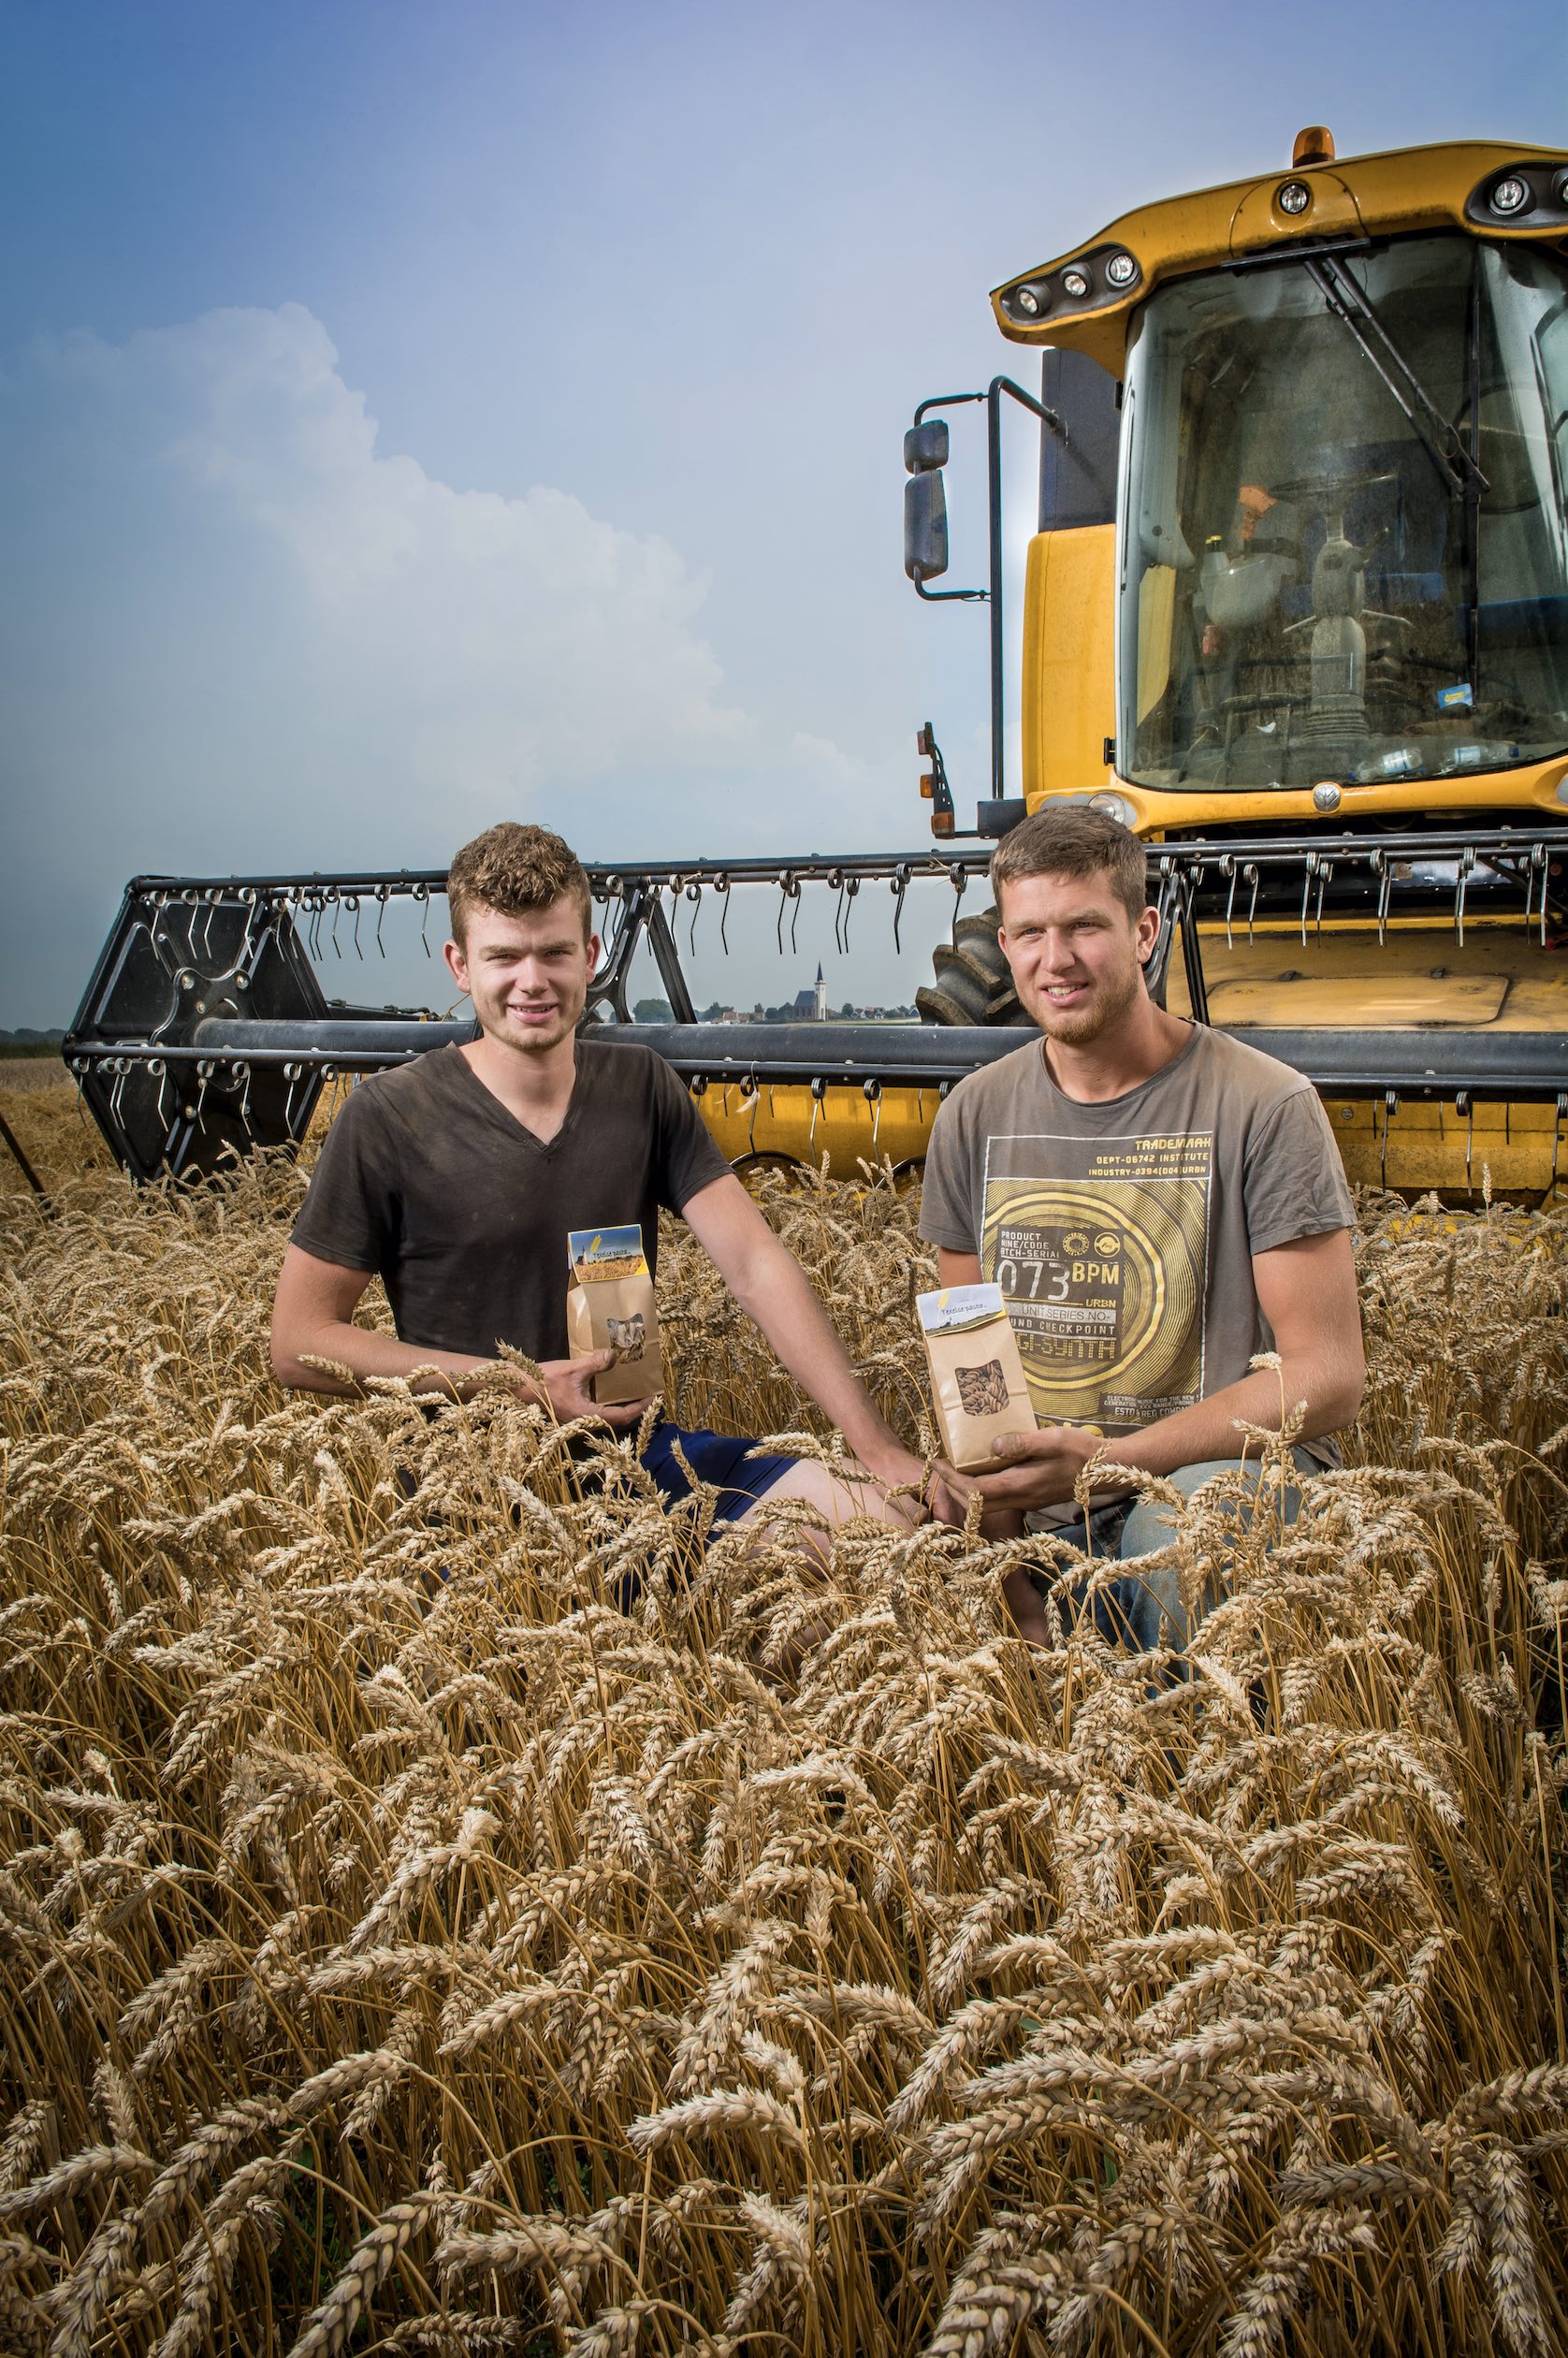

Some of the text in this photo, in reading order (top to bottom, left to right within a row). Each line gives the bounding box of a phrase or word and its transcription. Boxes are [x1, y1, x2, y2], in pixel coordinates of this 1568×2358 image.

[1160, 1152, 1209, 1162] INSTITUTE
[1001, 1230, 1041, 1241] PRODUCT
[1001, 1240, 1049, 1250] NINE/CODE
[996, 1259, 1119, 1301] 073 BPM
[1086, 1299, 1116, 1308] URBN
[1022, 1305, 1045, 1317] UNIT
[1048, 1308, 1084, 1320] SERIES
[1039, 1320, 1115, 1335] CHECKPOINT
